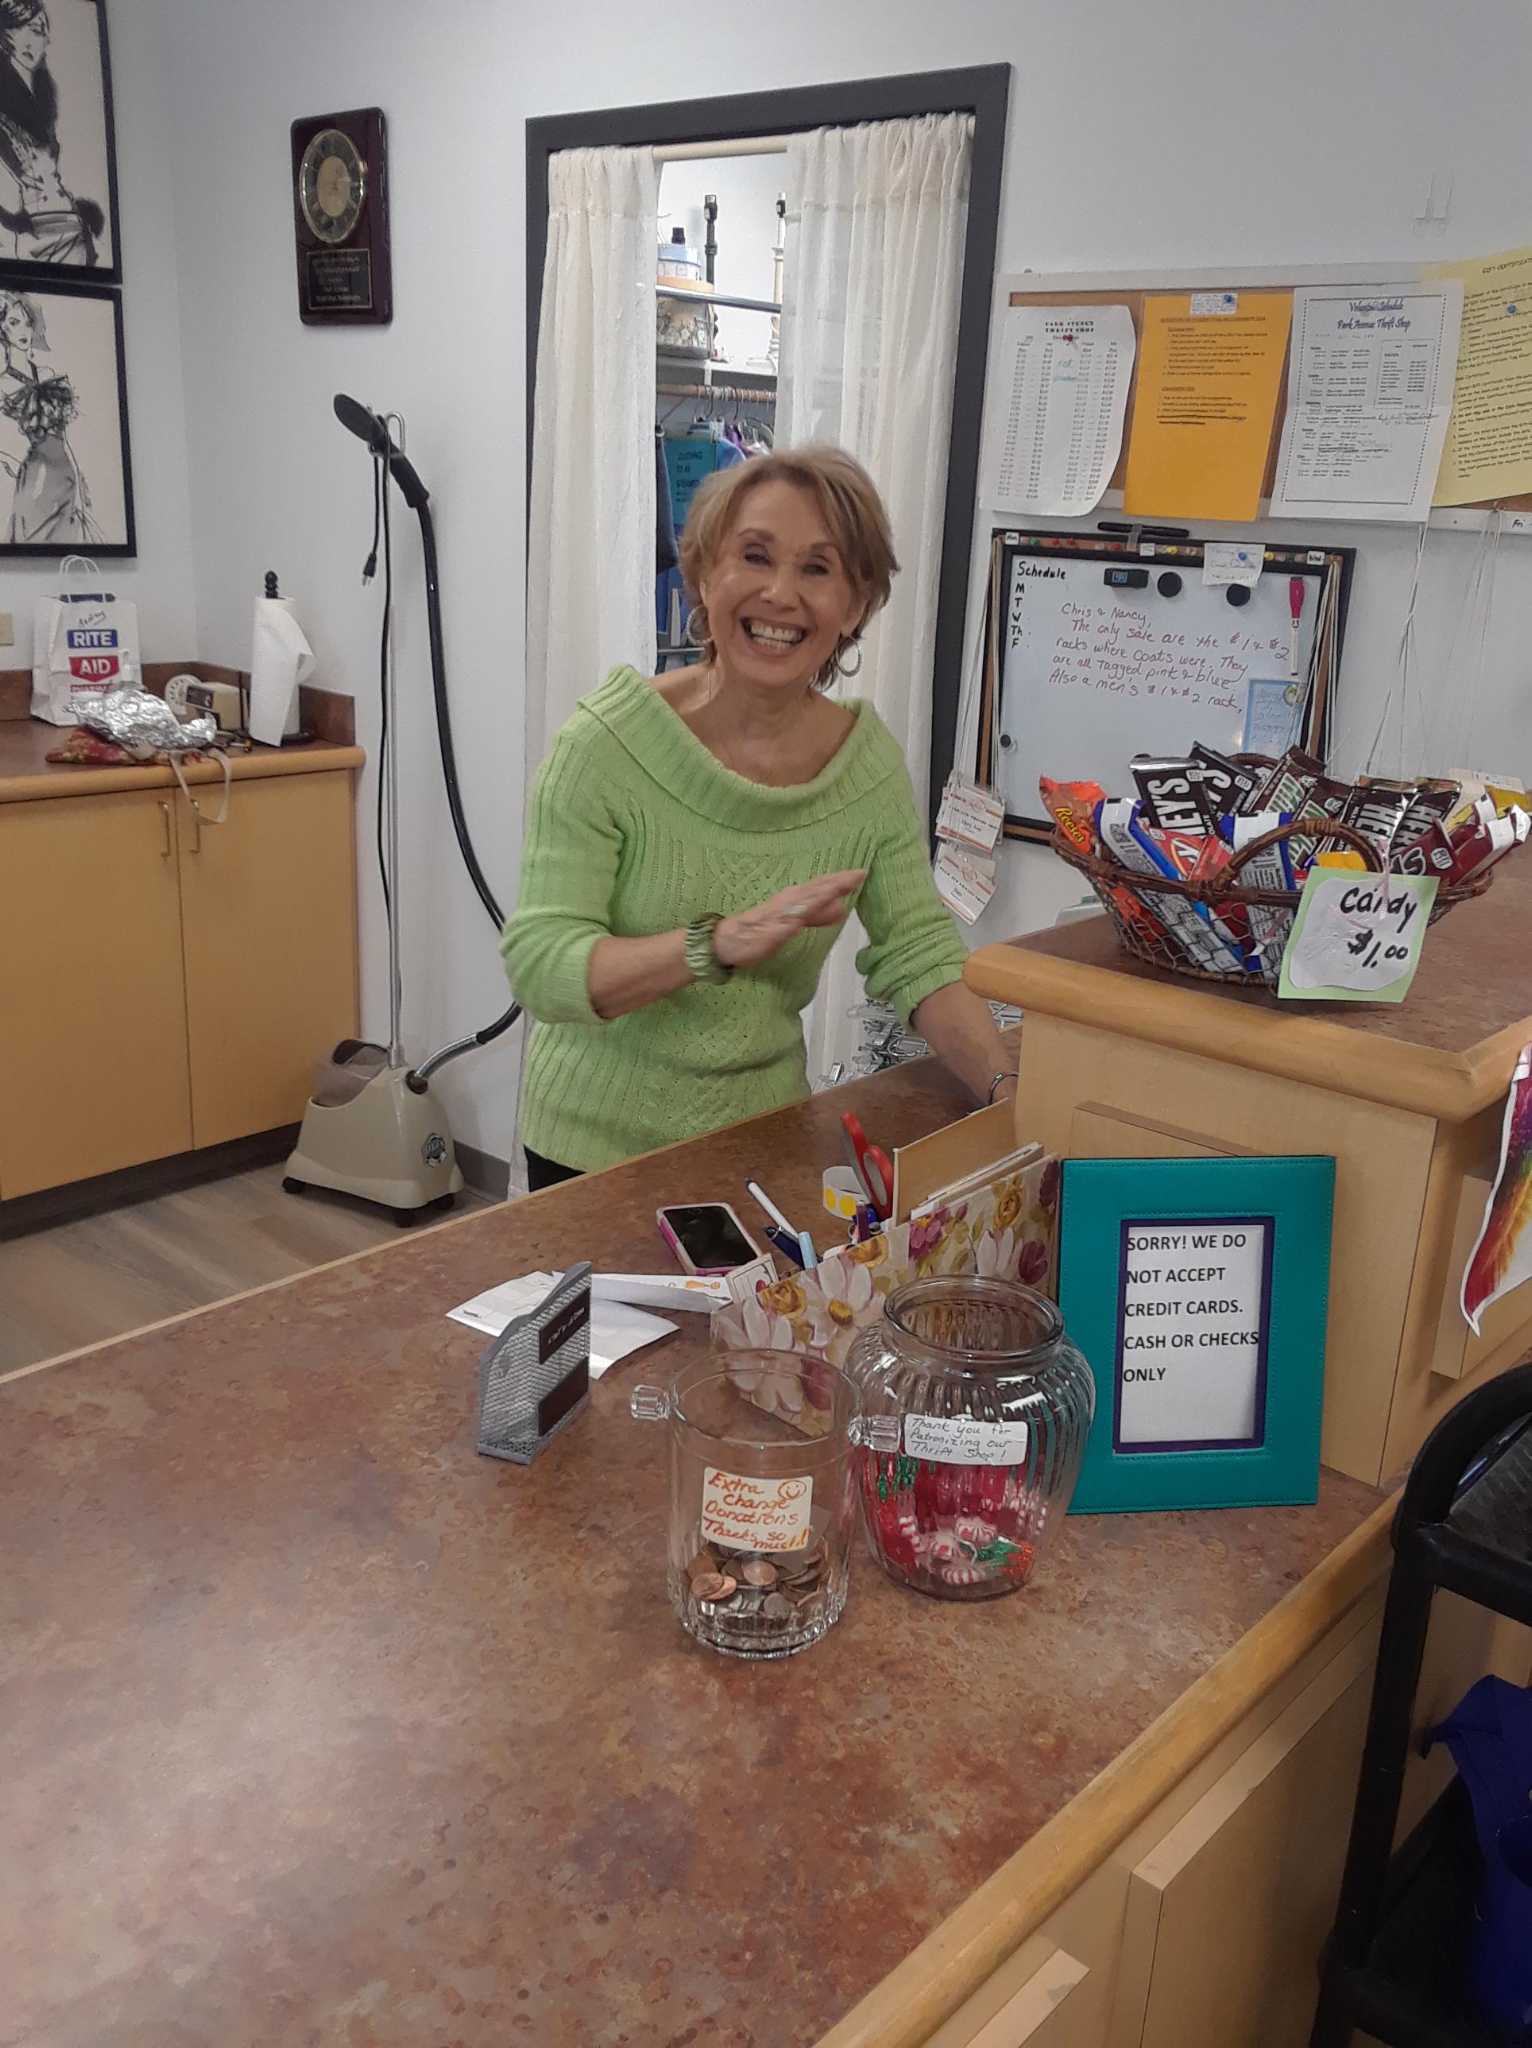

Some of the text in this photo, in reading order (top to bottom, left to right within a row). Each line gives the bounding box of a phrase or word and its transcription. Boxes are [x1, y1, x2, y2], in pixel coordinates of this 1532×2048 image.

[1017, 560, 1067, 580] Schedule
[1014, 583, 1025, 595] M
[1014, 597, 1023, 607] T
[1061, 602, 1092, 617] Chris
[1011, 612, 1022, 622] W
[72, 630, 113, 647] RITE
[1010, 624, 1023, 637] Th
[1072, 618, 1091, 632] The
[1097, 621, 1121, 645] only
[1126, 625, 1155, 642] sale
[1161, 633, 1185, 646] are
[1011, 638, 1020, 649] F
[80, 658, 112, 676] AID
[1055, 636, 1088, 652] racks
[1093, 640, 1128, 658] where
[1220, 655, 1249, 683] They
[1048, 667, 1079, 685] Also
[1081, 677, 1091, 686] a
[1052, 654, 1073, 666] are
[1076, 657, 1092, 669] all
[1144, 665, 1179, 681] pink
[1195, 668, 1233, 690] blue
[1347, 928, 1410, 969] $1.00
[1127, 1233, 1247, 1251] SORRY! WE DO
[1126, 1266, 1227, 1285] NOT ACCEPT
[1125, 1299, 1244, 1317] CREDIT CARDS.
[1124, 1331, 1260, 1350] CASH OR CHECKS
[1122, 1366, 1167, 1383] ONLY
[911, 1417, 1012, 1439] Thank you for
[911, 1440, 953, 1457] Thrift
[986, 1439, 1009, 1449] our
[707, 1471, 765, 1495] Extra
[704, 1499, 800, 1526] Donations
[767, 1530, 787, 1542] so
